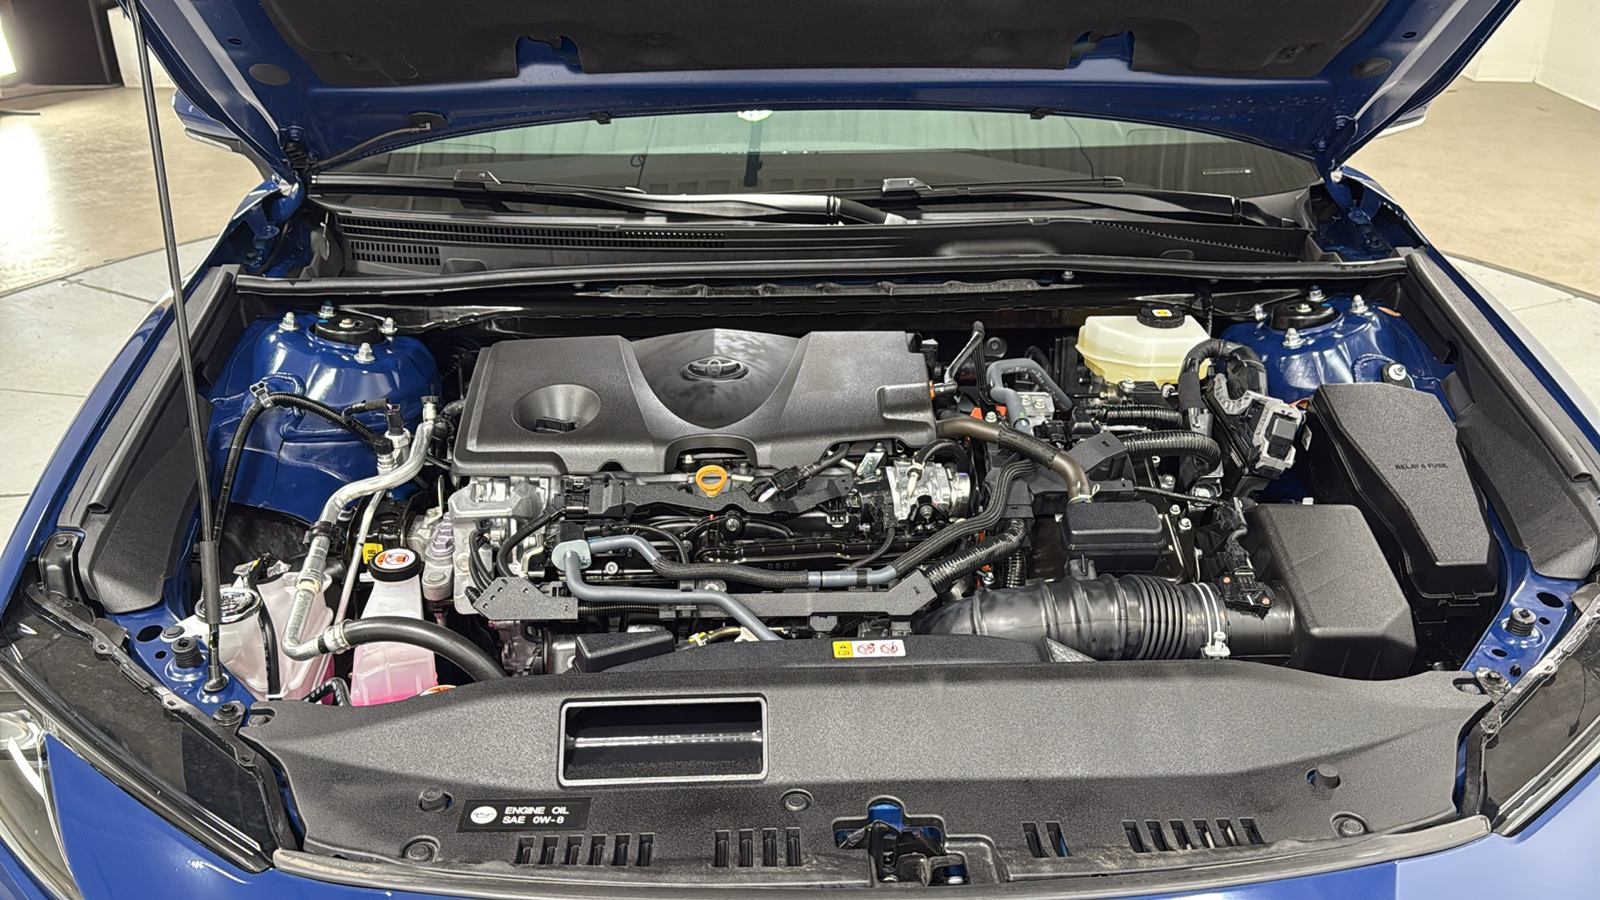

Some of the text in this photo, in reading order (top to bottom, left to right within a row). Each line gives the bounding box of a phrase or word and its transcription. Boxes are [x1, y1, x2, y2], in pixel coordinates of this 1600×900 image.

[504, 806, 570, 815] ENGINE OIL
[502, 815, 565, 824] SAE 0W-8
